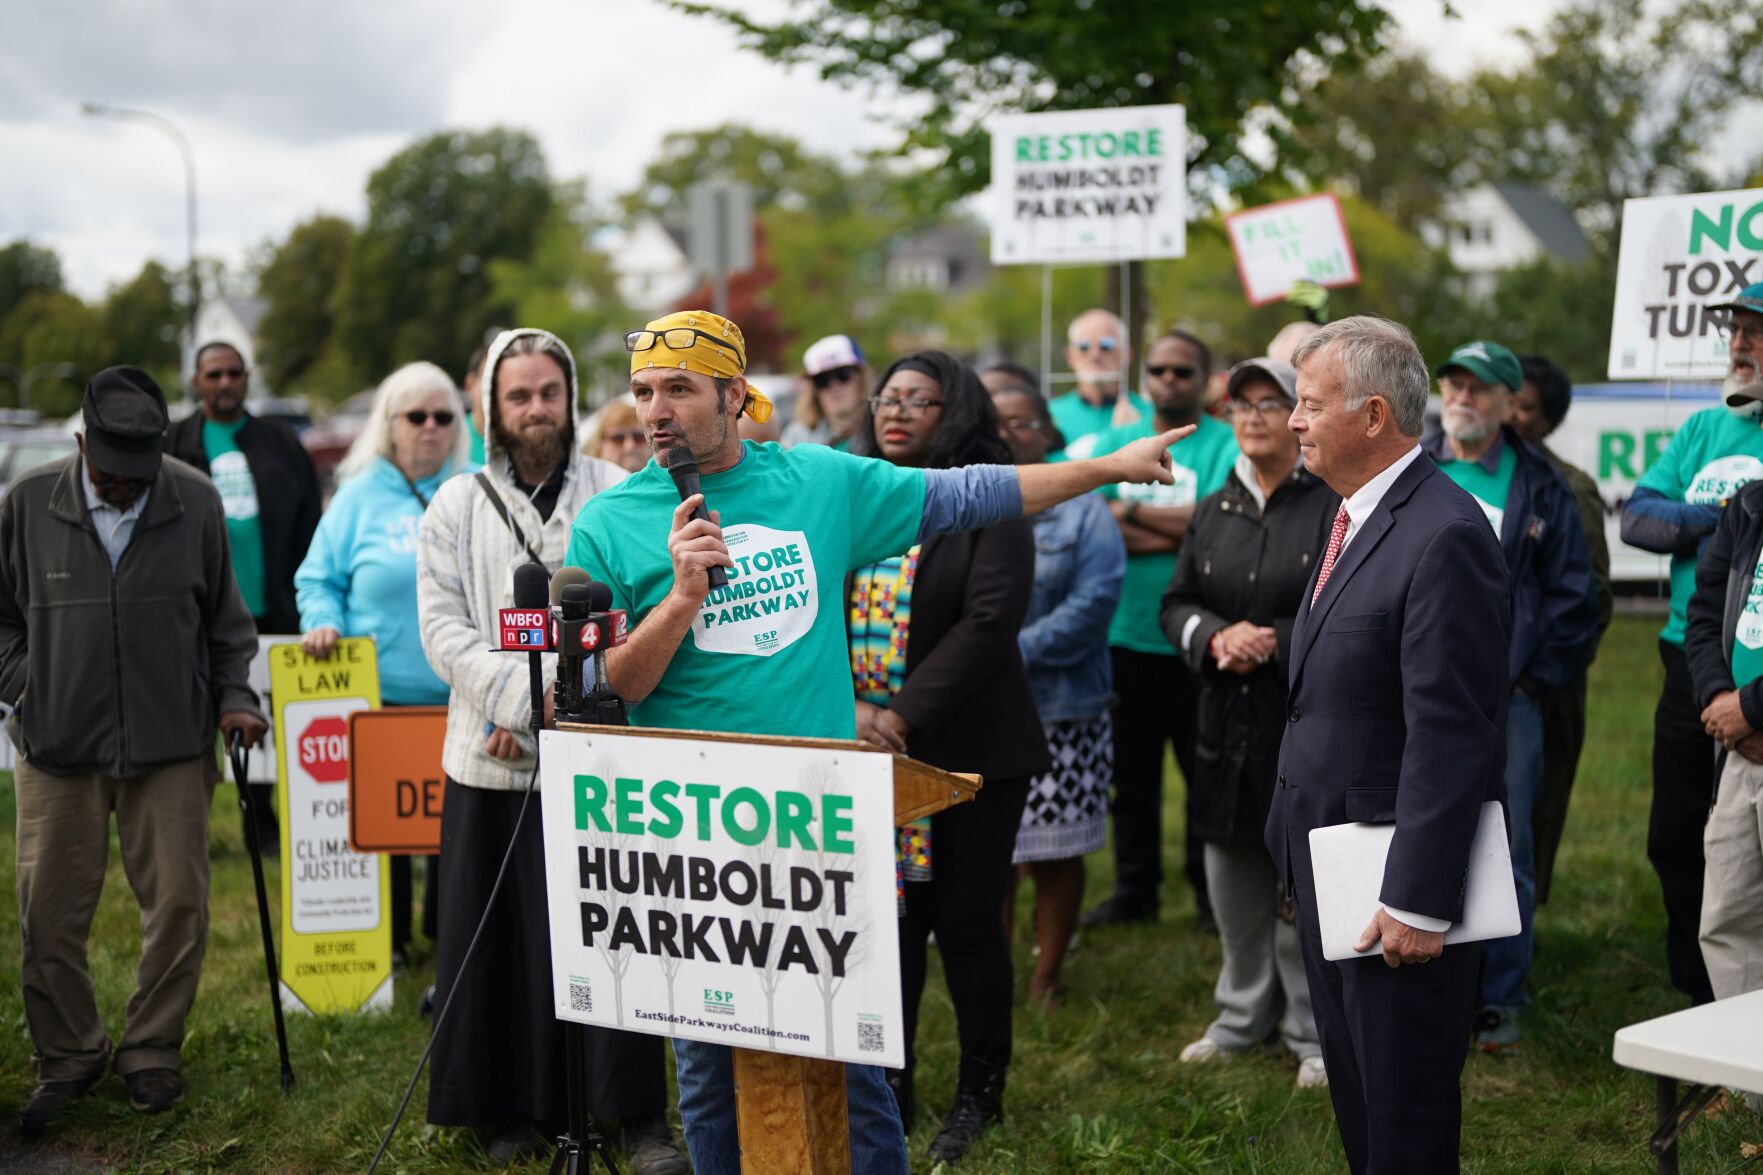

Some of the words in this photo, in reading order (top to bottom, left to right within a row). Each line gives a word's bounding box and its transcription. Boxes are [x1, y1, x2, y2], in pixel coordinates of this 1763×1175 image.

[1015, 129, 1162, 162] RESTORE
[1015, 165, 1160, 190] HUMBOLDT
[1015, 192, 1160, 220] PARKWAY
[1243, 214, 1306, 246] FILL
[1279, 239, 1302, 262] IT
[503, 613, 543, 626] WBFO
[703, 590, 809, 629] PARKWAY
[507, 631, 540, 644] npr
[581, 623, 598, 646] 4
[753, 630, 777, 642] ESP
[298, 670, 351, 694] LAW
[573, 774, 855, 855] RESTORE
[297, 858, 370, 882] JUSTICE
[577, 846, 855, 916] HUMBOLDT
[313, 940, 356, 956] BEFORE
[579, 902, 858, 978] PARKWAY
[295, 958, 377, 977] CONSTRUCTION
[704, 989, 733, 1002] ESP
[635, 1009, 811, 1043] EastSideParkwaysCoalition.com
